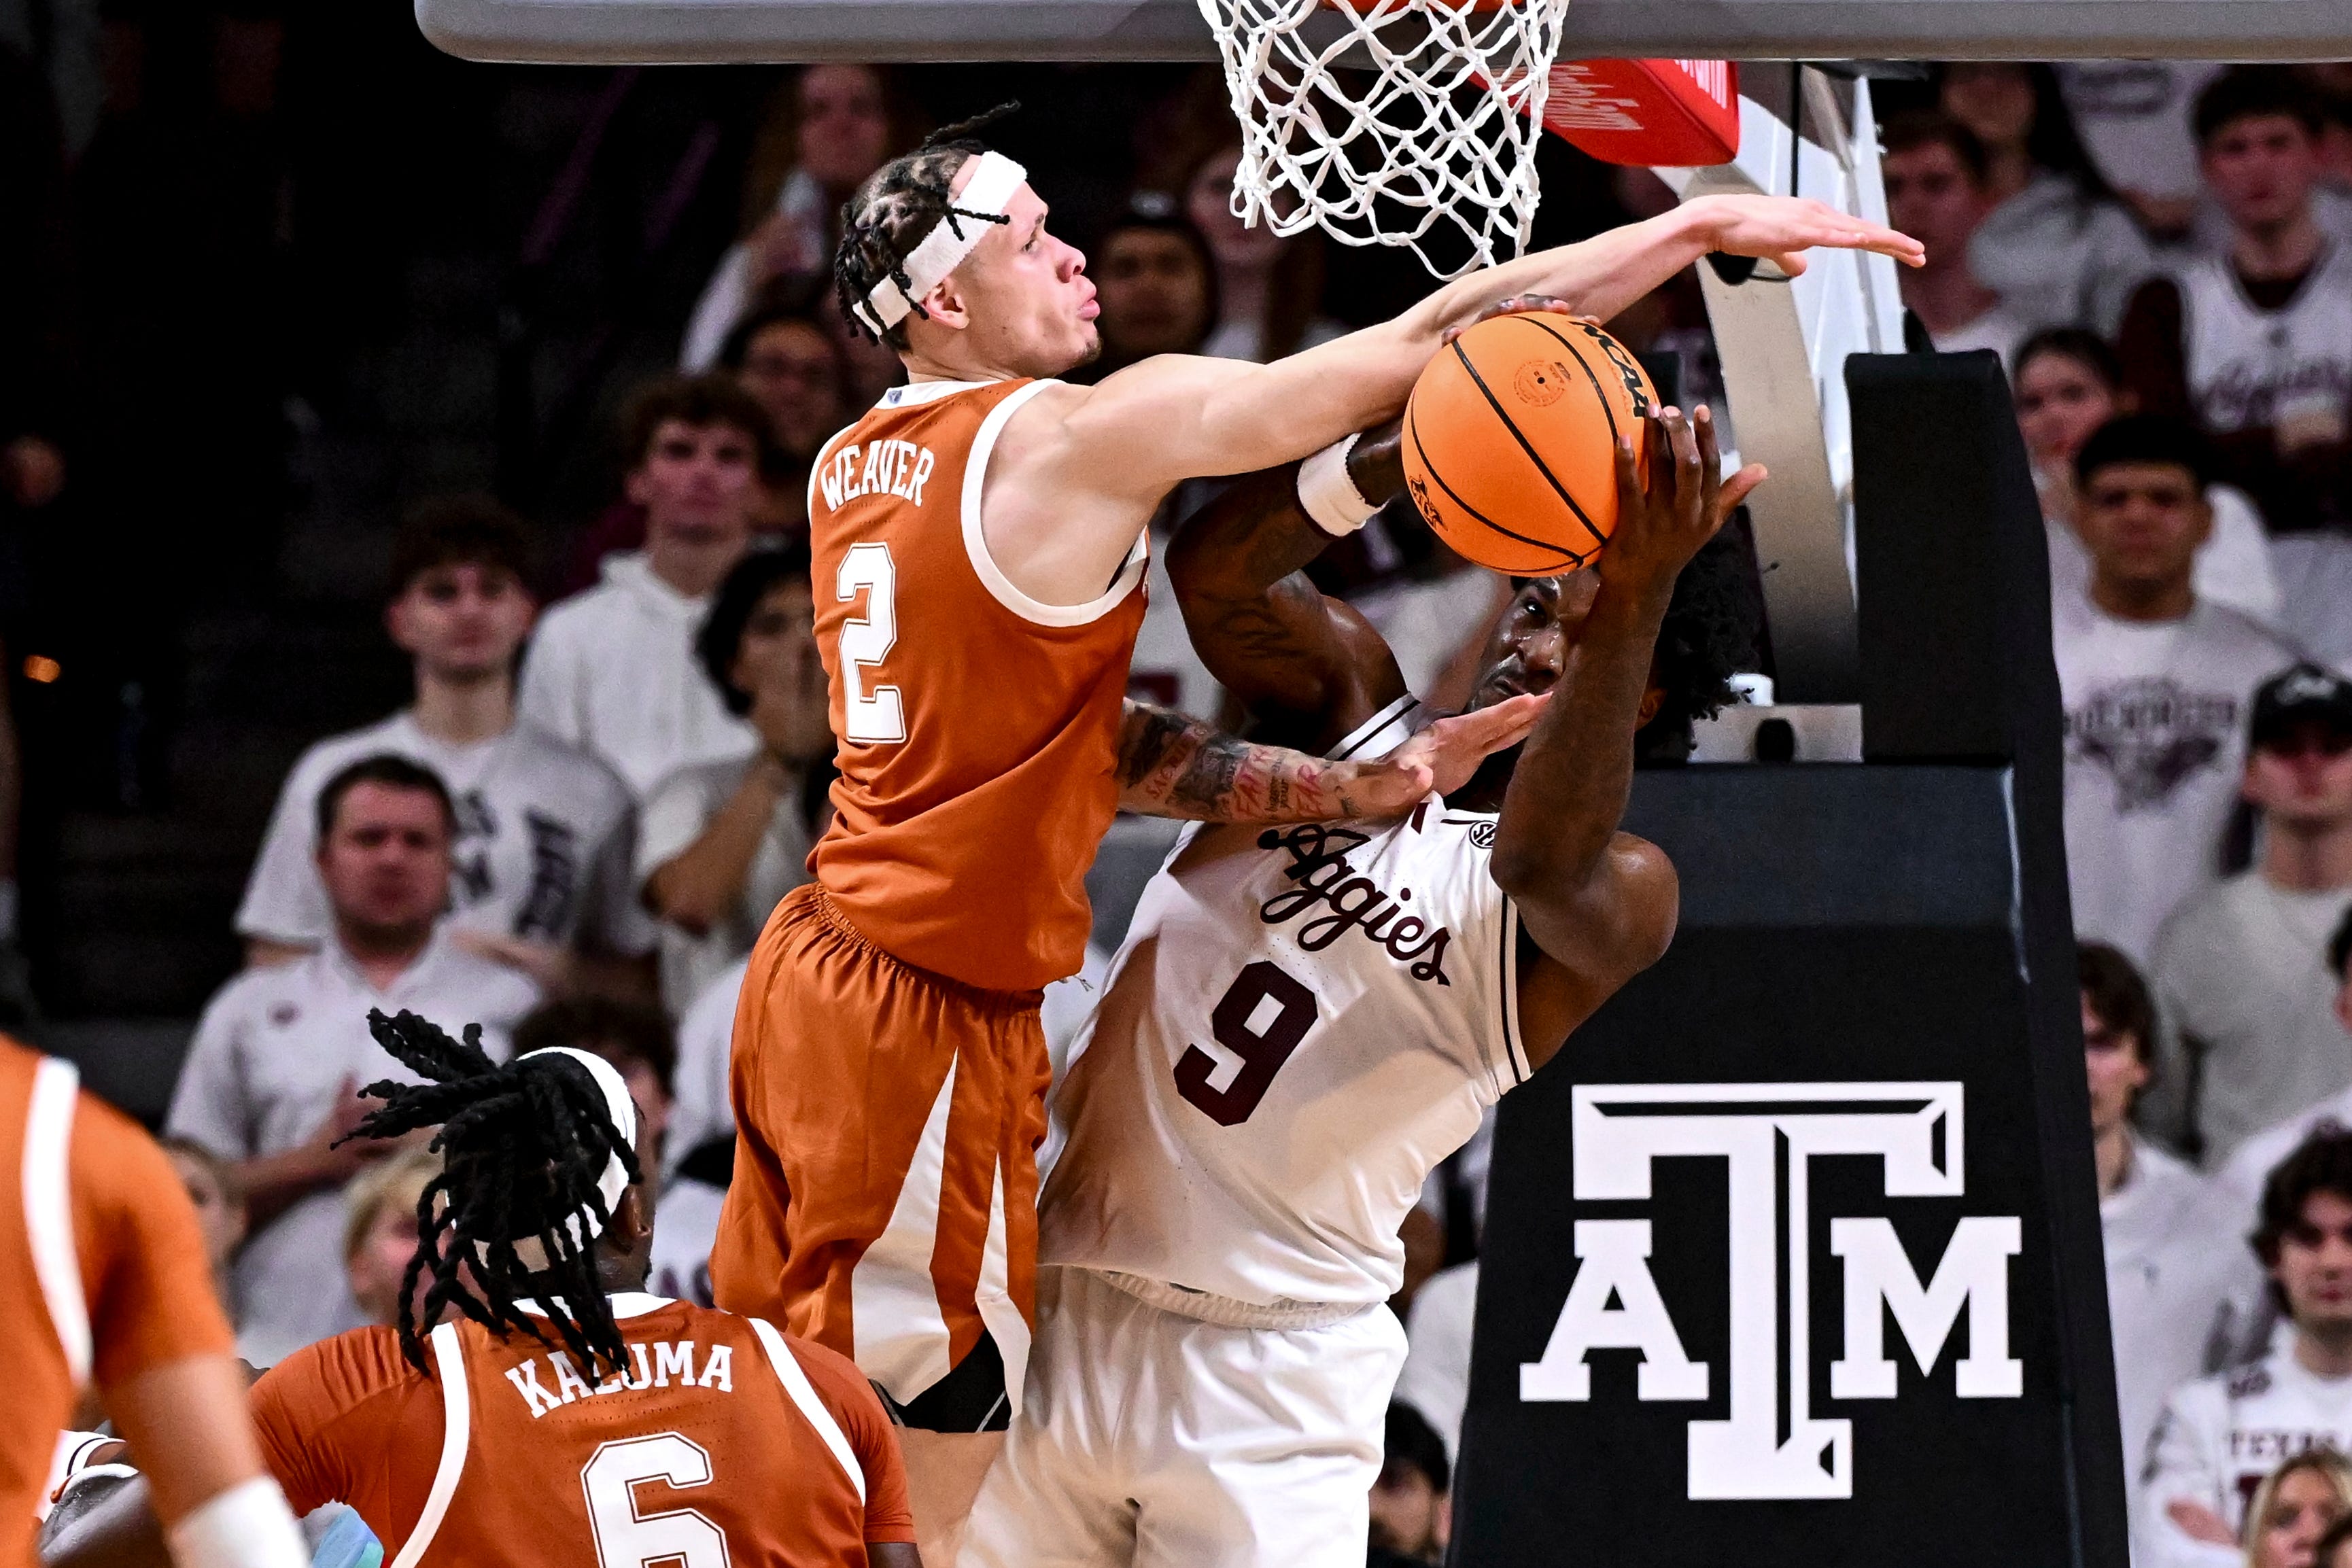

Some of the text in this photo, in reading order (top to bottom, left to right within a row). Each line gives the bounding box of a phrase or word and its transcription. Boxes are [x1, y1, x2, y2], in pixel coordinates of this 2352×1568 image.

[1568, 321, 1650, 417] NCAA
[820, 439, 935, 512] WEAVER
[836, 542, 906, 744] 2
[1258, 823, 1451, 988] Aggies
[1173, 960, 1319, 1128] 9
[579, 1431, 734, 1568] 6
